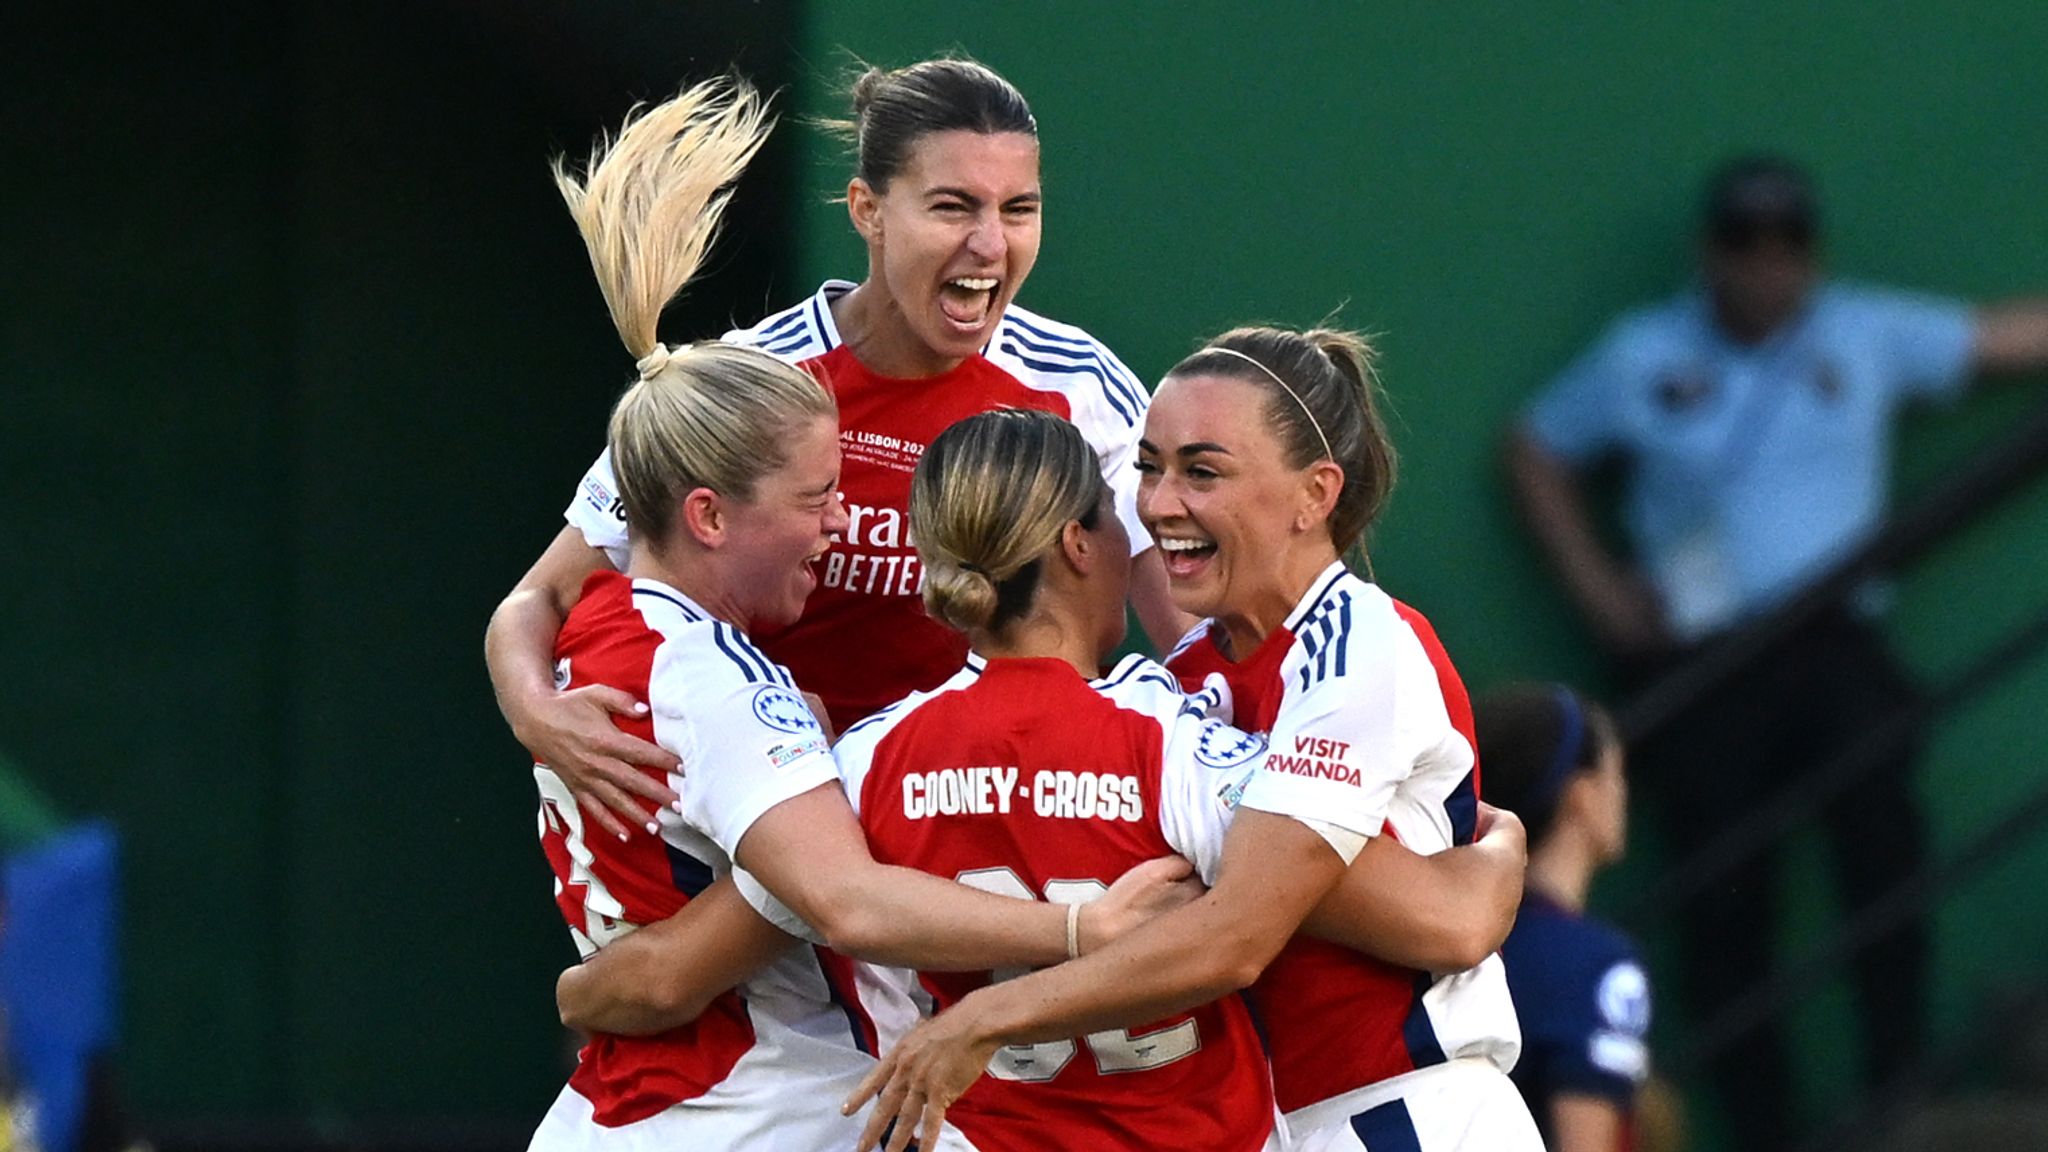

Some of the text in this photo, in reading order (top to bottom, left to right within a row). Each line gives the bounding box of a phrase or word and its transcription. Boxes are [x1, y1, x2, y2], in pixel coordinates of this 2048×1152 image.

[840, 430, 854, 442] AL
[857, 431, 901, 450] LISBON
[902, 440, 925, 456] 202
[1295, 735, 1350, 761] VISIT
[1264, 754, 1361, 787] RWANDA
